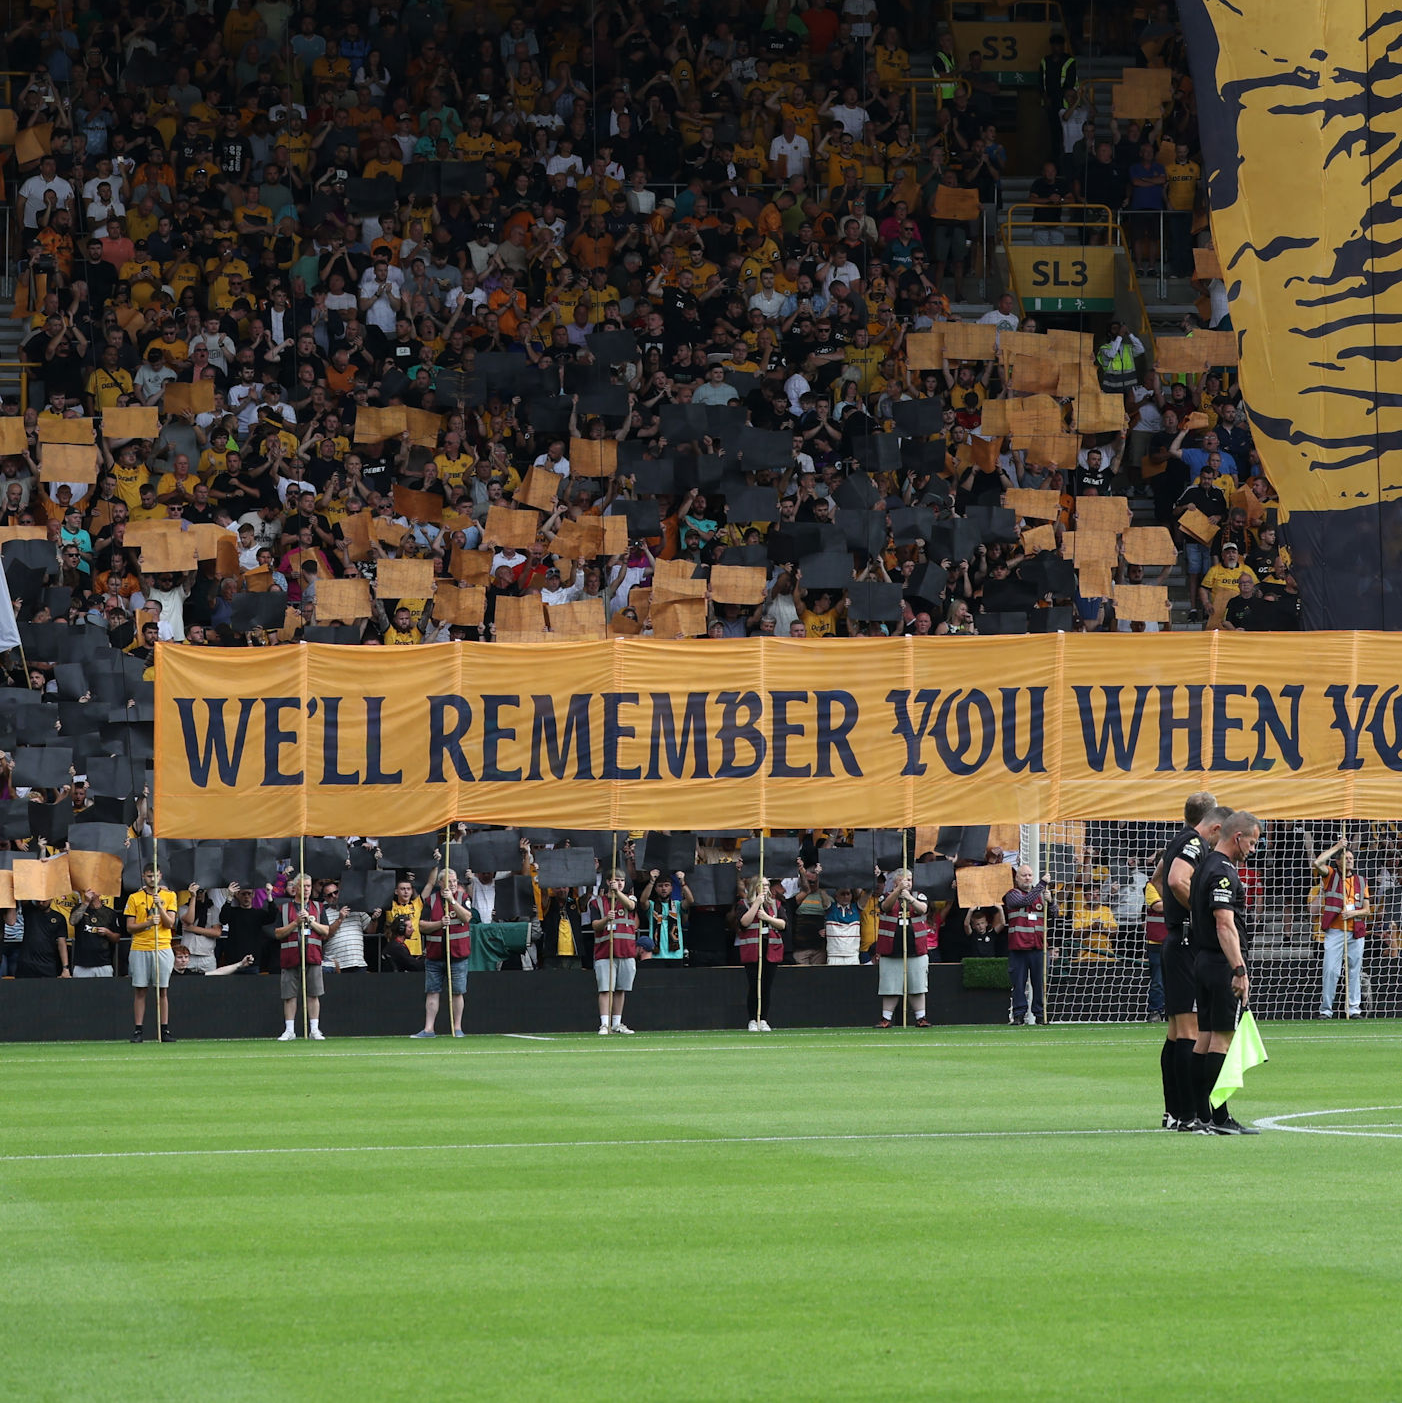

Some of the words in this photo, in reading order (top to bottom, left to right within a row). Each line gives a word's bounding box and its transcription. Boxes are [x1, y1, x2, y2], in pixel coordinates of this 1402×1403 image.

[983, 36, 1018, 60] S3
[1033, 260, 1088, 287] SL3
[363, 465, 386, 475] DEBET
[1082, 477, 1104, 485] DEBET
[174, 695, 403, 787] WE'LL
[426, 689, 864, 784] REMEMBER
[885, 685, 1049, 776] YOU
[1070, 684, 1305, 772] WHEN
